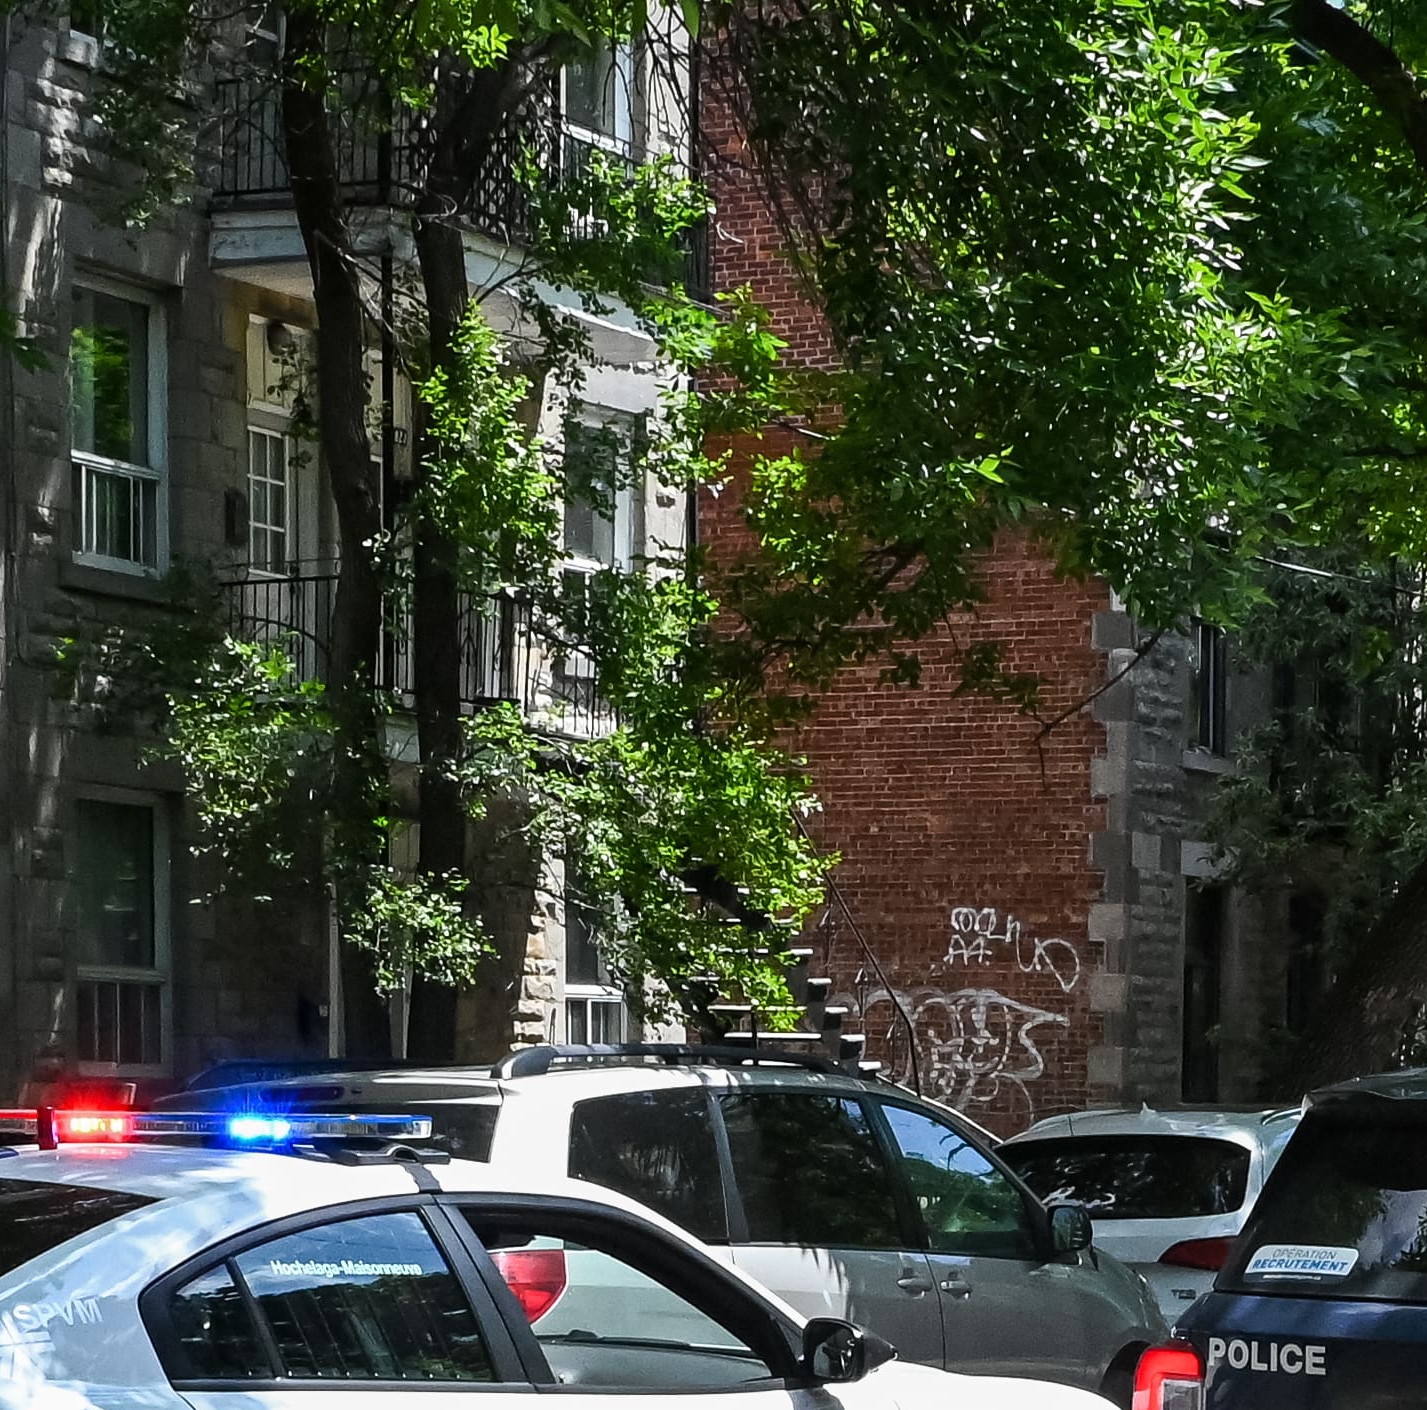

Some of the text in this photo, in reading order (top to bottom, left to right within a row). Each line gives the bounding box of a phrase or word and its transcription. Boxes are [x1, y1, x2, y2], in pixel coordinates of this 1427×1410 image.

[1272, 1247, 1337, 1260] OPÉRATION
[270, 1259, 423, 1278] Hochelaga-Maisonneuve
[1251, 1258, 1349, 1272] RECRUTEMENT
[12, 1297, 104, 1332] SPVM
[1208, 1336, 1327, 1376] POLICE
